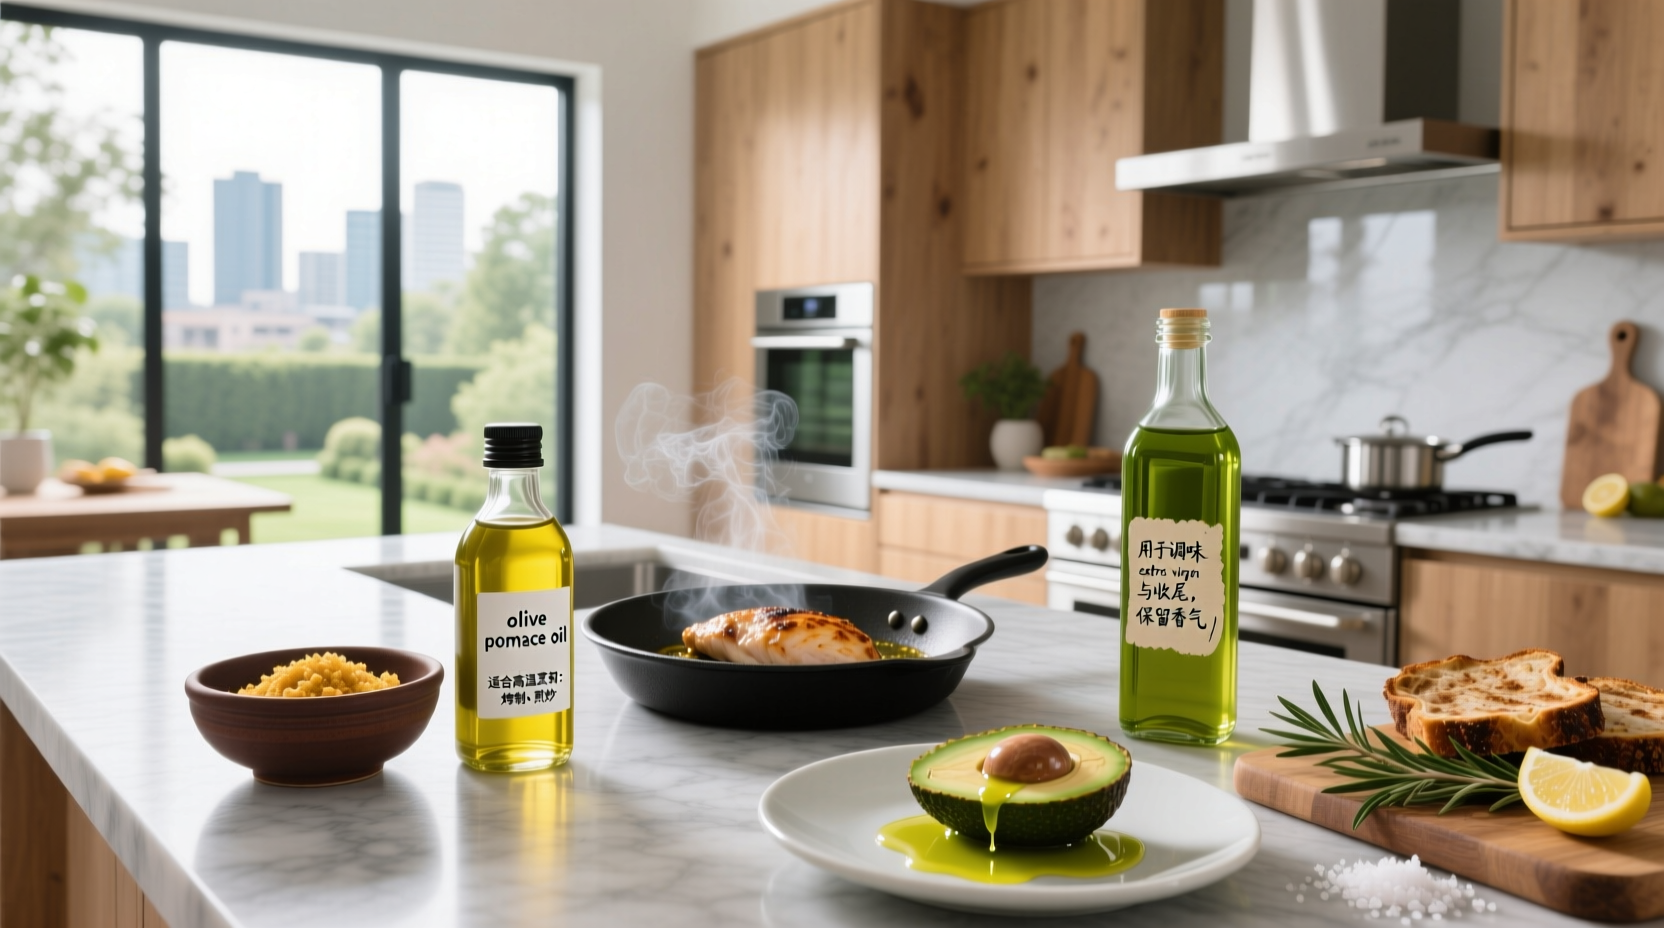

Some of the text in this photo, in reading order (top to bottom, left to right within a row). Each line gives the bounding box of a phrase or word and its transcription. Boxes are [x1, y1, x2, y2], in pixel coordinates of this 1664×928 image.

[1138, 540, 1208, 563] 用于调味
[507, 610, 547, 628] olive
[485, 625, 567, 652] pomace oil
